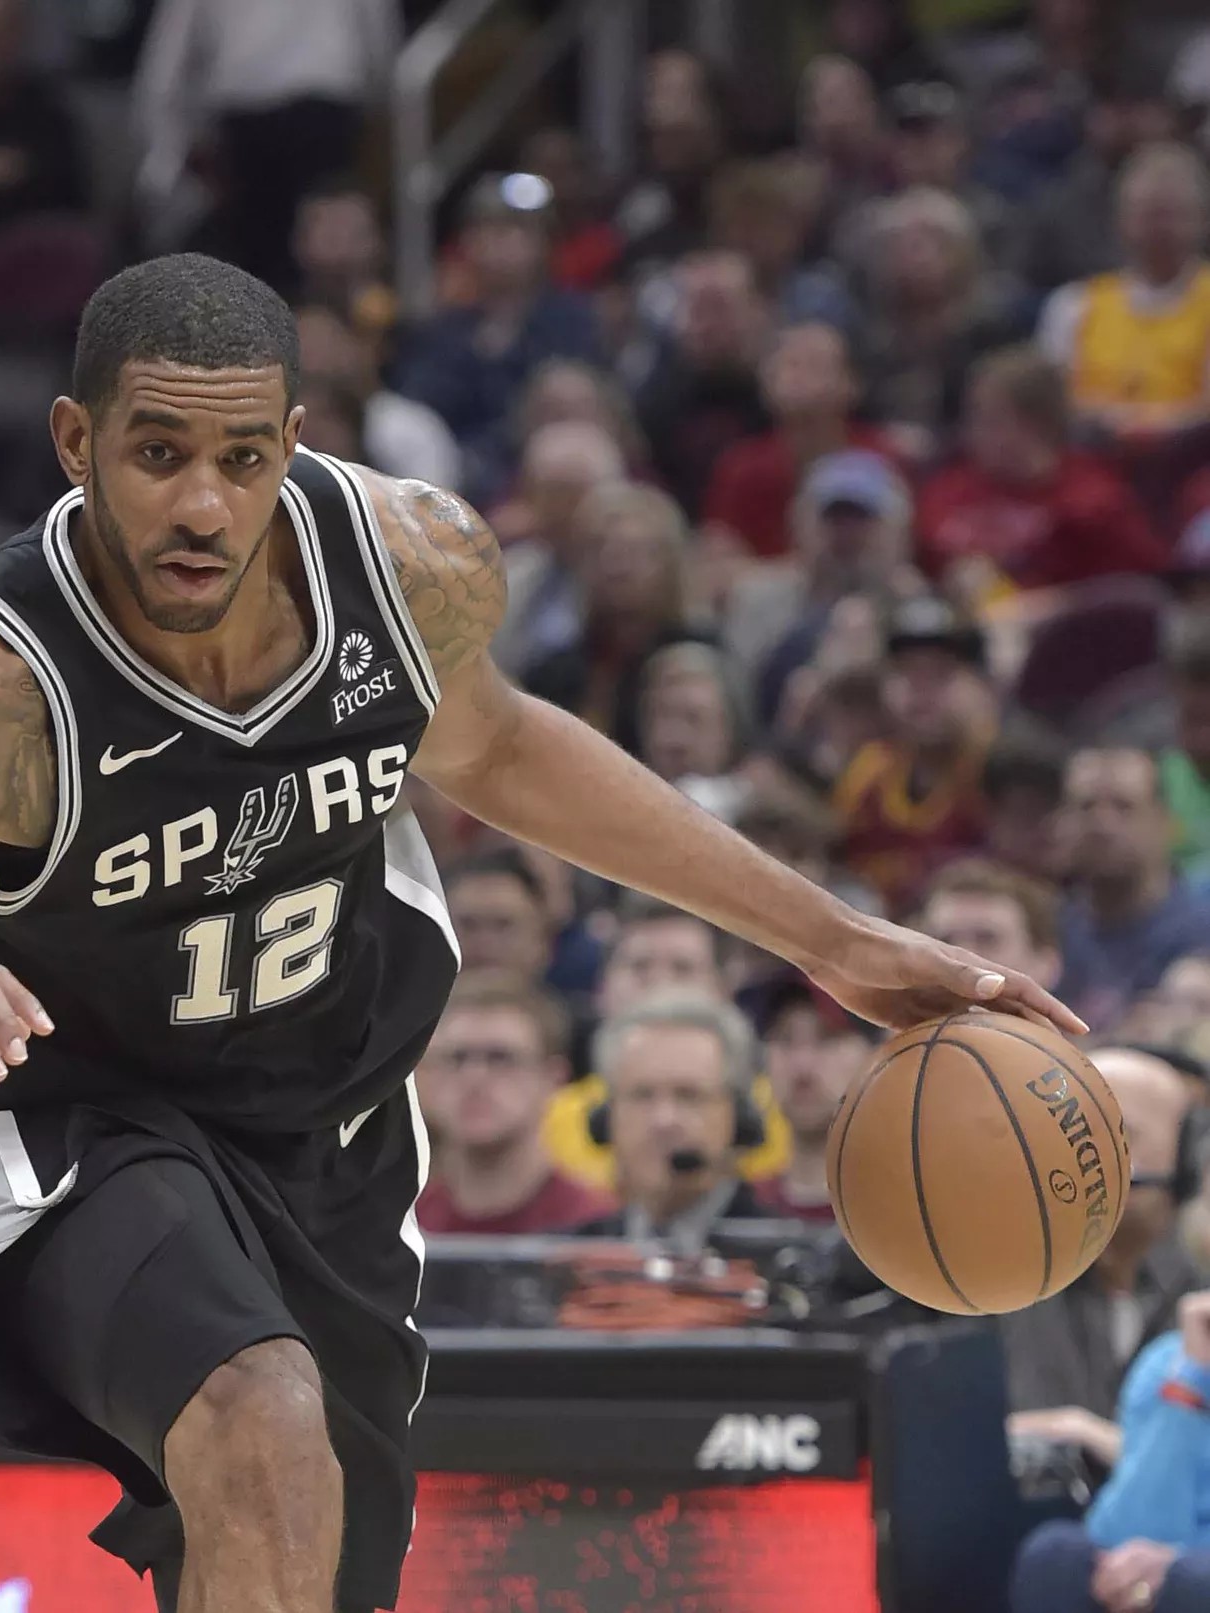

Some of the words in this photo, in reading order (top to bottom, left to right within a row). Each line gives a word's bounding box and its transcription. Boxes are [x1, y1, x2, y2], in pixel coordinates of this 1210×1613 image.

[332, 667, 397, 725] Frost
[91, 743, 407, 907] SPURS
[169, 877, 344, 1025] 12
[1026, 1066, 1109, 1263] PALDING
[695, 1413, 821, 1472] ANC
